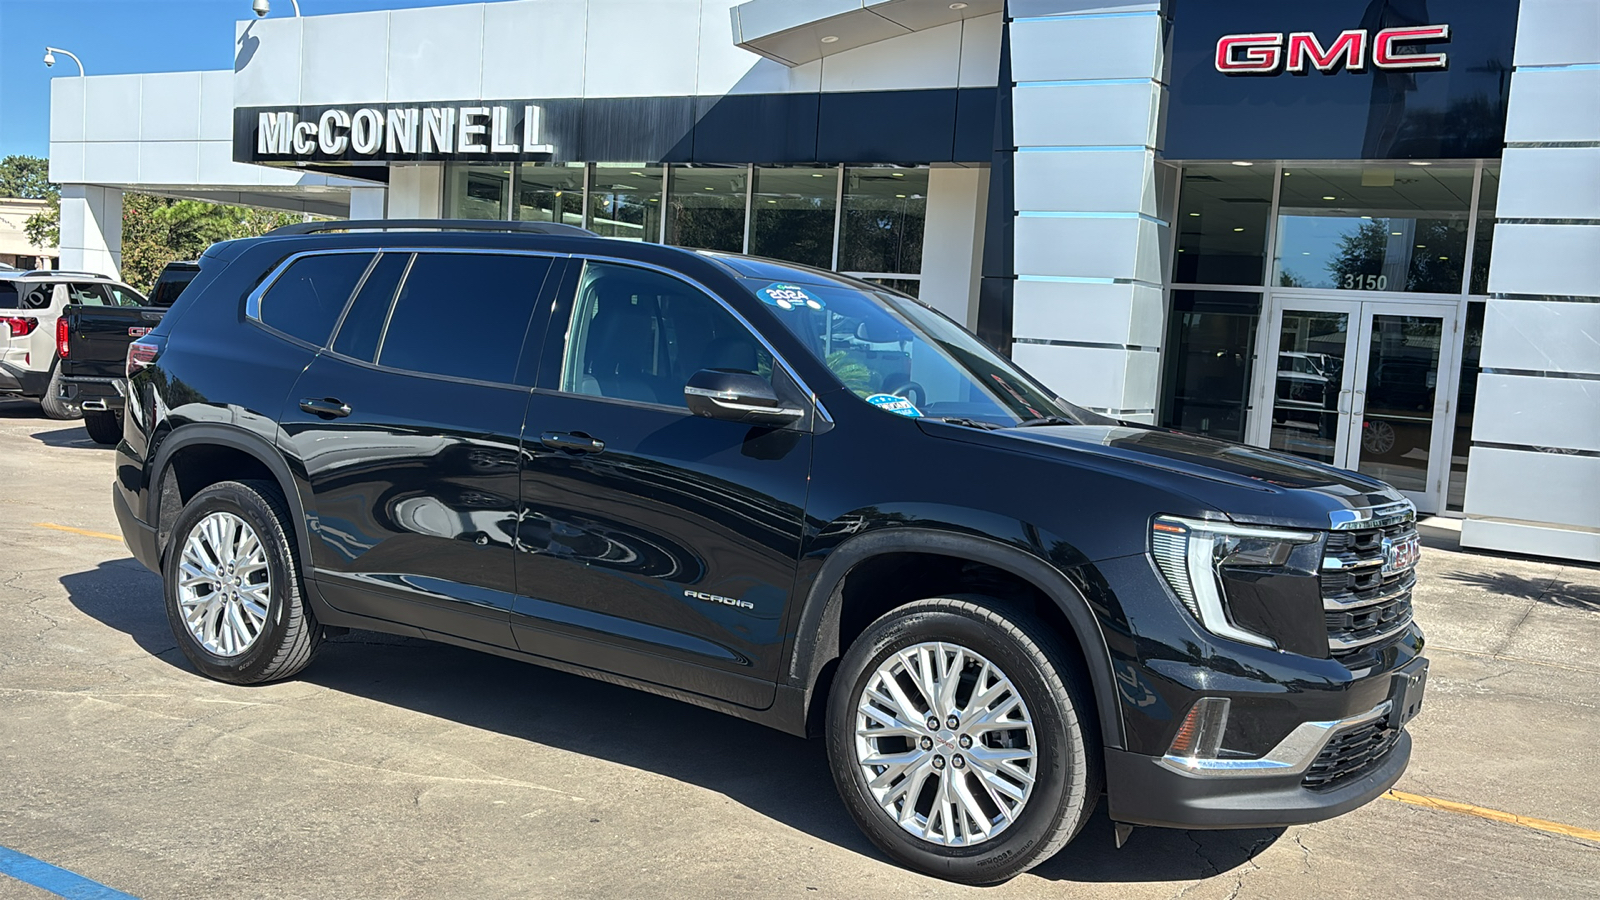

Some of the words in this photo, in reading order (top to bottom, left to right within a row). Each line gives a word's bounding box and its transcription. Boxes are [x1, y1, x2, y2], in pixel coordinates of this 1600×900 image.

[1215, 24, 1449, 73] GMC
[257, 105, 553, 155] McCONNELL
[1344, 273, 1388, 290] 3150
[766, 289, 809, 300] 2024
[684, 589, 754, 609] ACADIA
